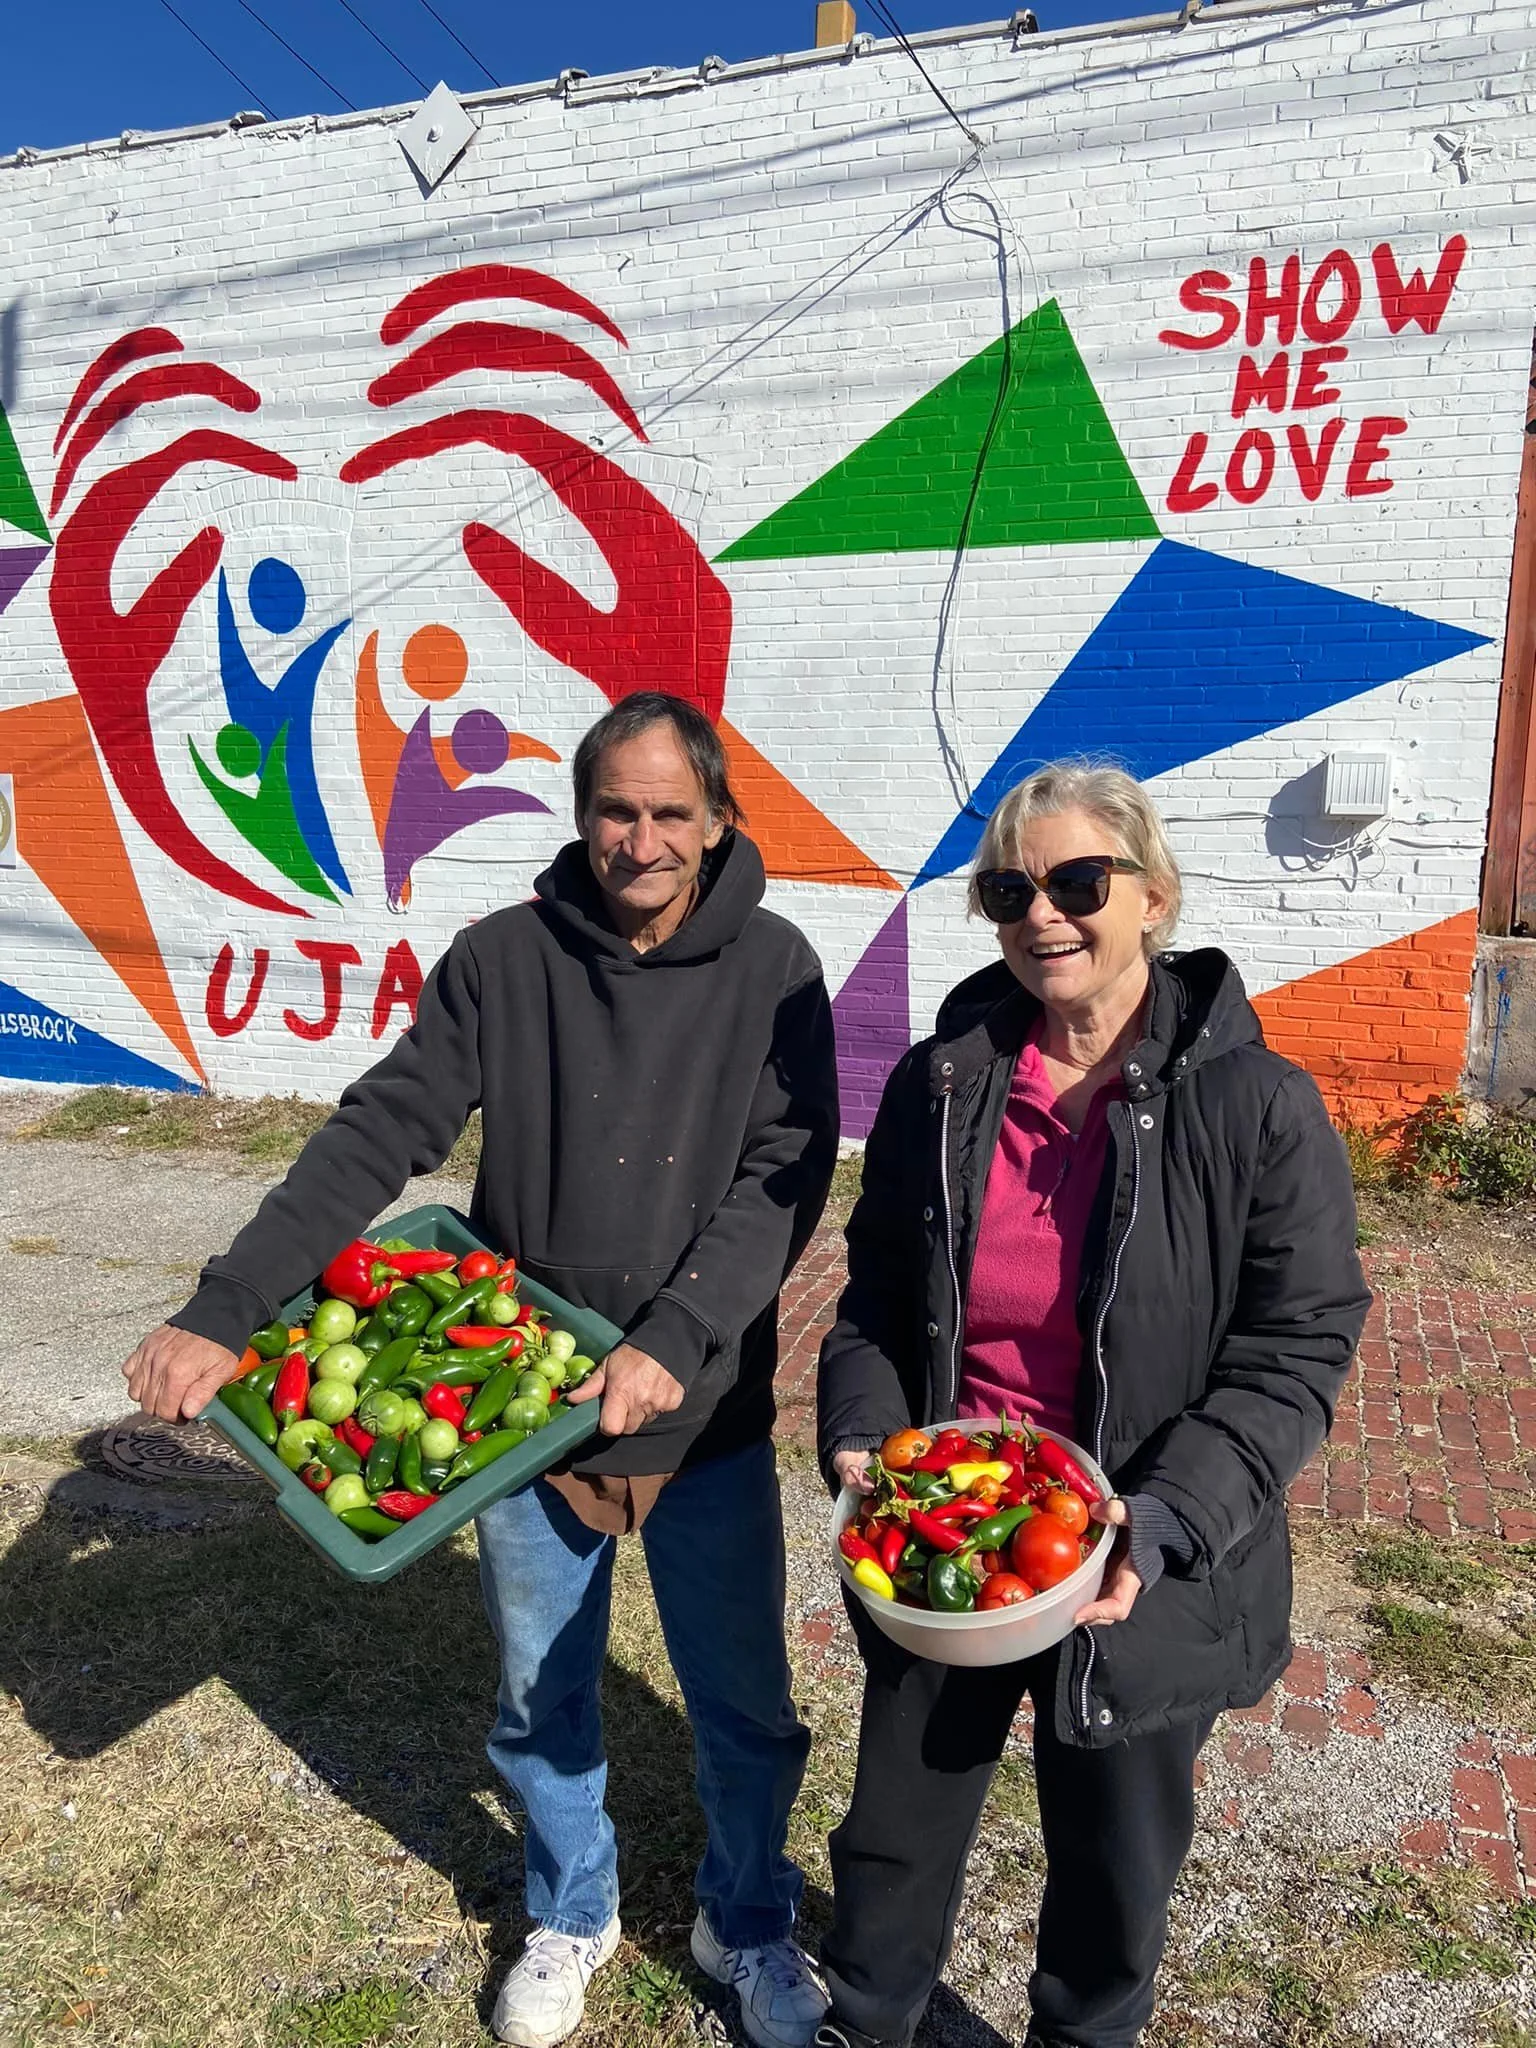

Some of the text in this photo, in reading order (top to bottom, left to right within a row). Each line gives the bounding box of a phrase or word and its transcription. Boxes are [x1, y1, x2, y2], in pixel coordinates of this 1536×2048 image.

[1158, 233, 1468, 351] SHOW
[1231, 346, 1349, 419] ME
[1165, 416, 1409, 514] LOVE
[0, 1013, 78, 1045] LSBROCK
[205, 938, 425, 1042] UJA
